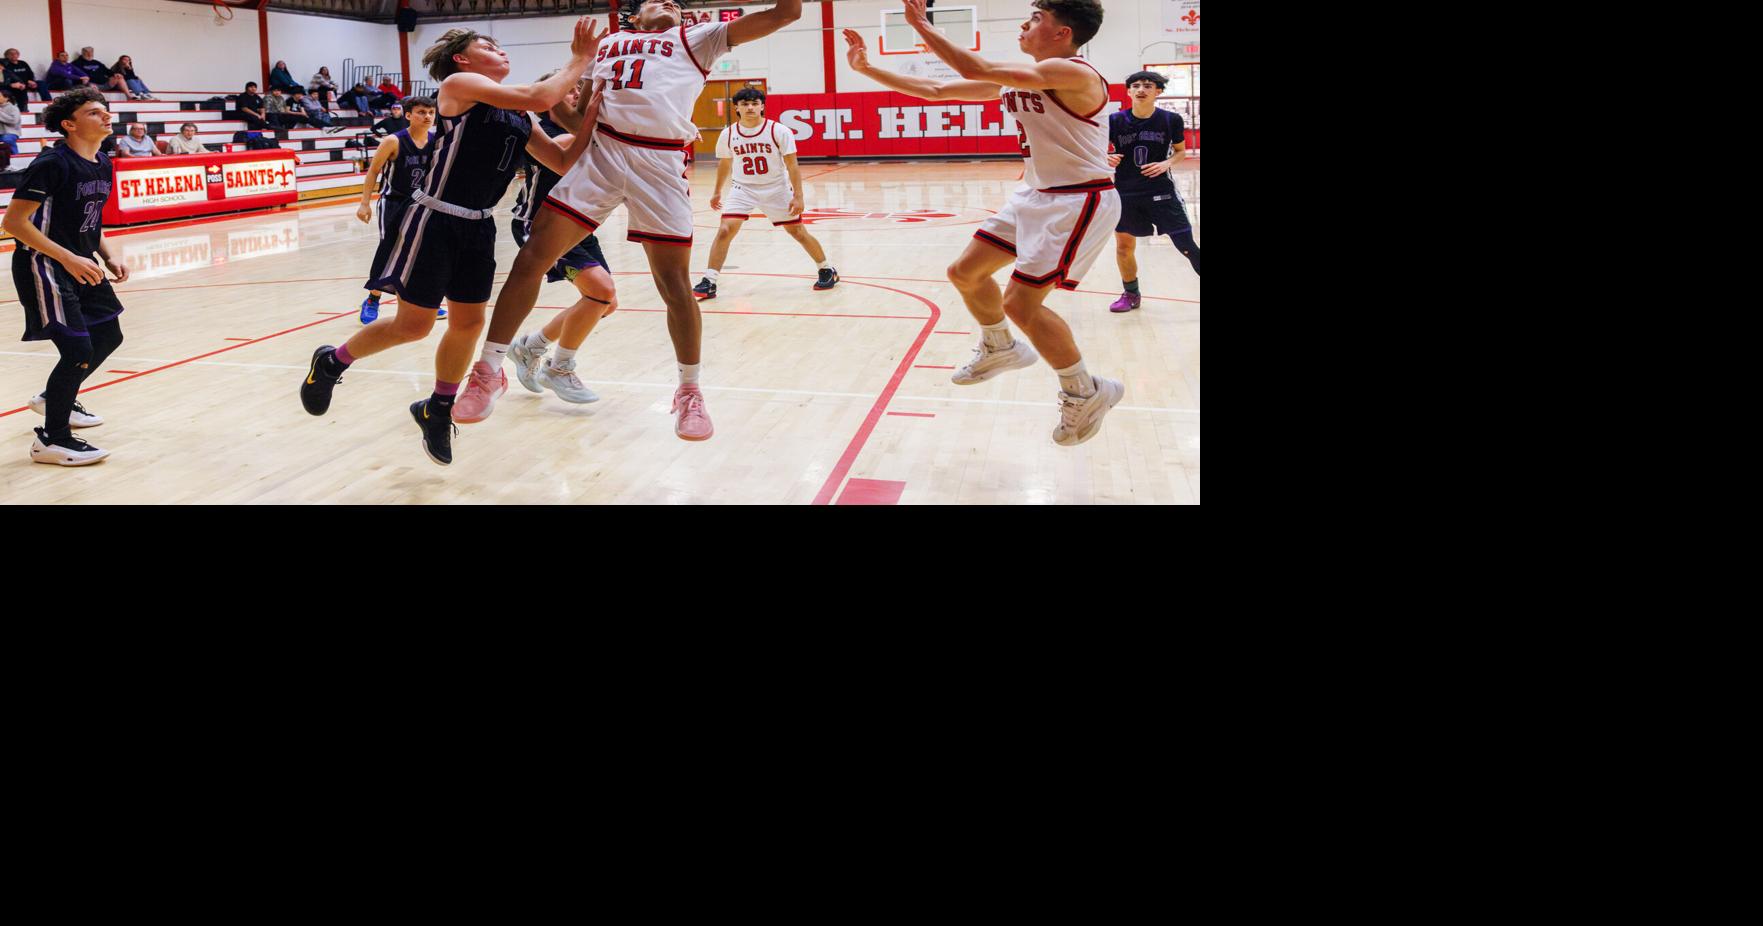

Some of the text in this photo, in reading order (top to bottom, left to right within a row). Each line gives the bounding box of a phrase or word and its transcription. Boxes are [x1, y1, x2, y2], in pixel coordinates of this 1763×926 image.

[596, 38, 674, 63] SAINTS
[611, 59, 646, 91] 11
[1003, 90, 1046, 114] NTS
[497, 134, 518, 172] 1
[733, 142, 772, 156] SAINTS
[742, 155, 769, 176] 20
[226, 169, 275, 189] SAINTS
[410, 168, 426, 189] 2
[142, 194, 186, 204] HIGH SCHOOL
